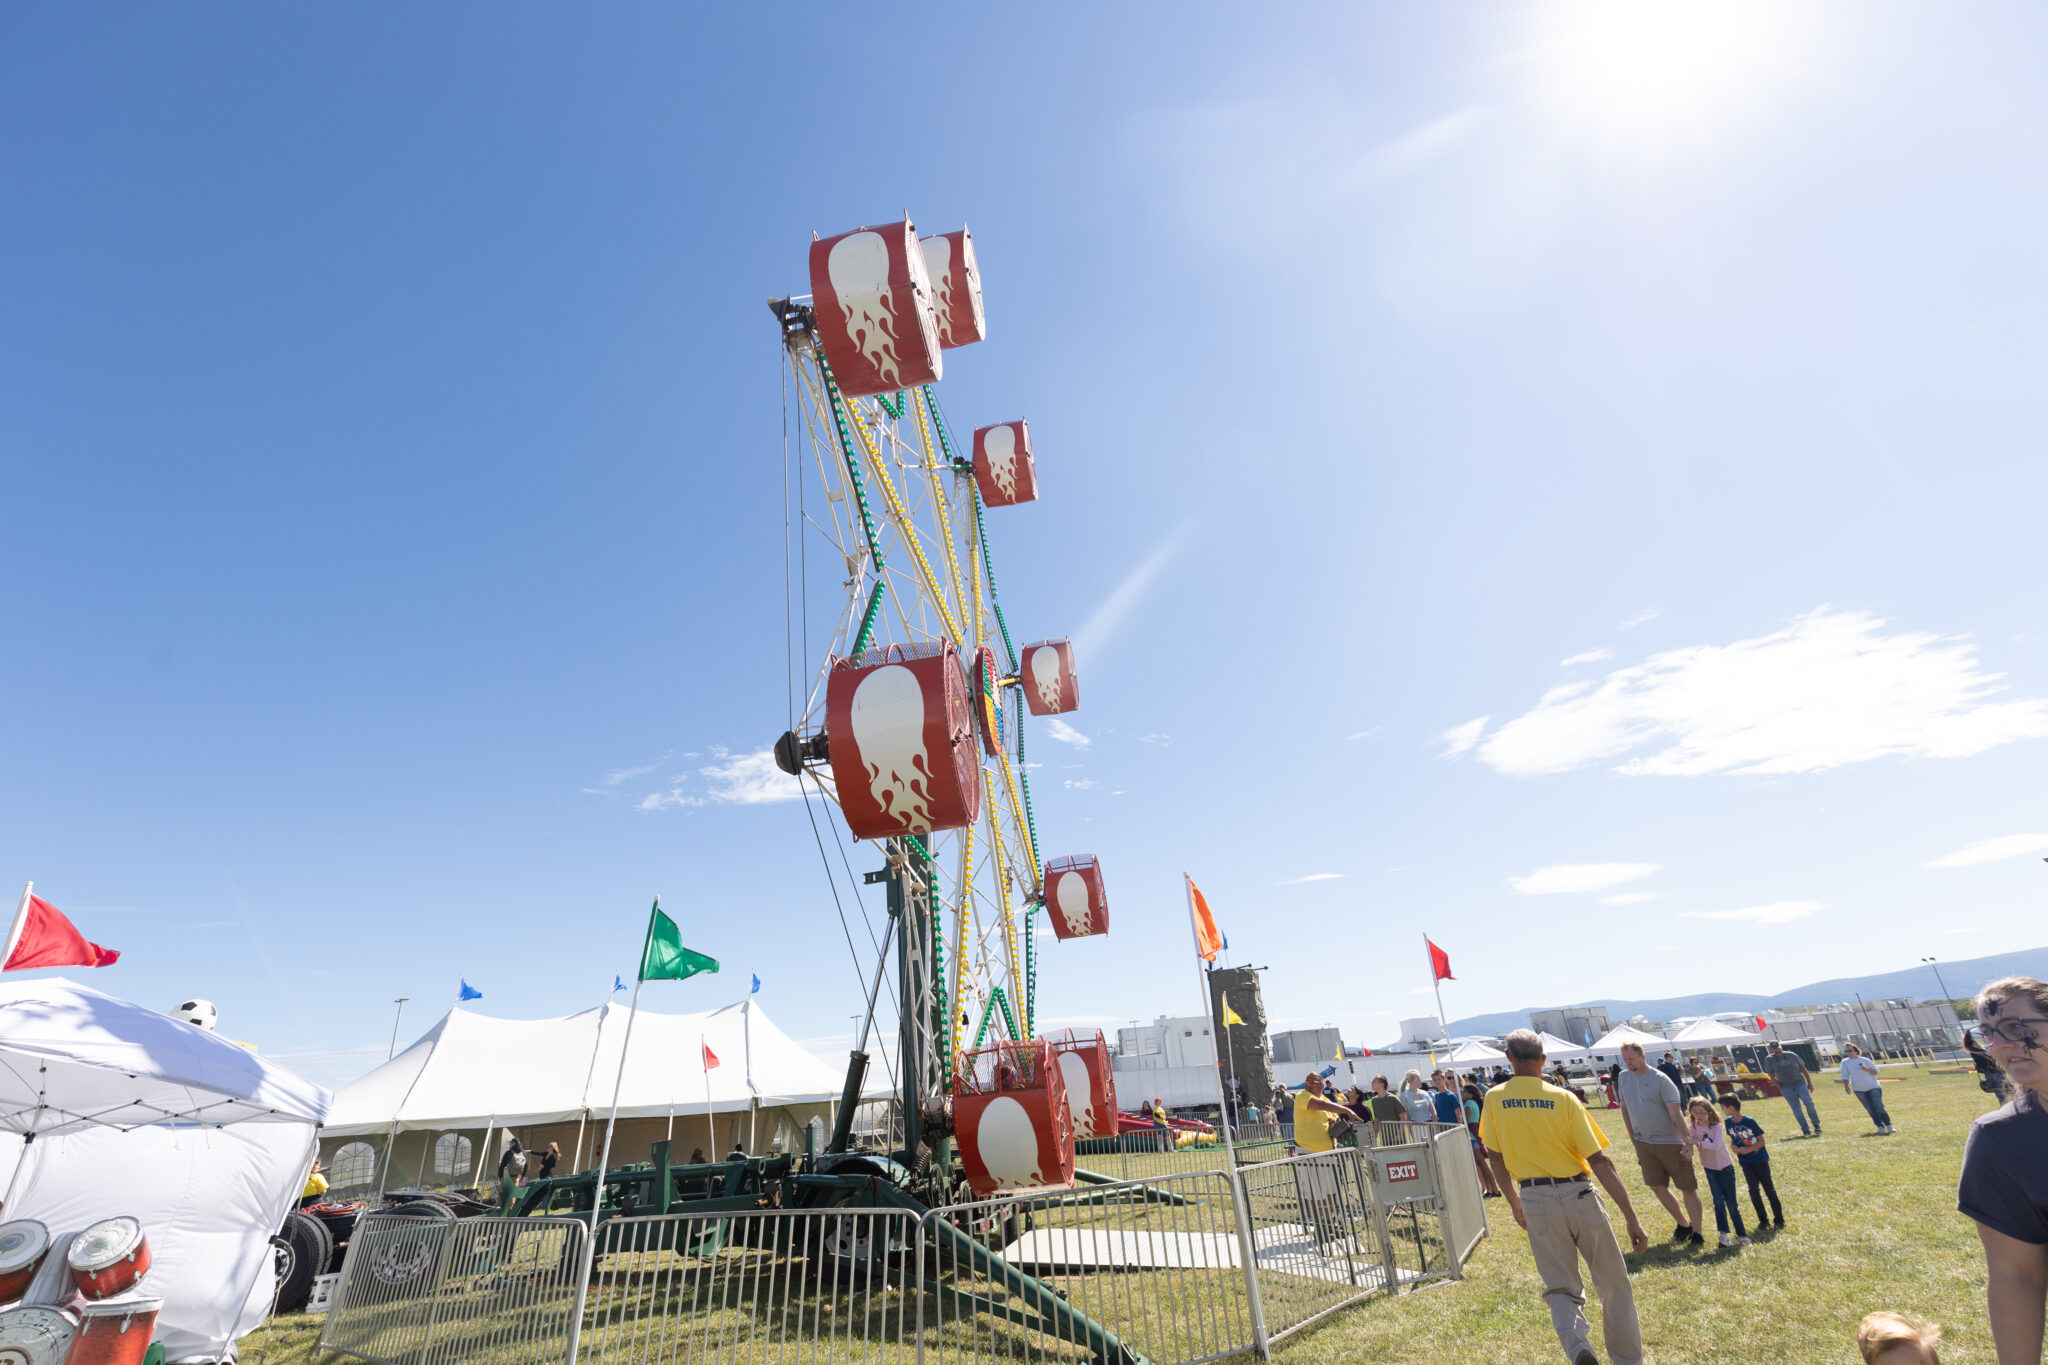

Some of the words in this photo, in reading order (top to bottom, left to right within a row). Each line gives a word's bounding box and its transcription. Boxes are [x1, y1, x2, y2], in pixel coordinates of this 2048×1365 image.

[1502, 1099, 1527, 1109] EVENT
[1529, 1099, 1555, 1110] STAFF
[1389, 1164, 1416, 1180] EXIT
